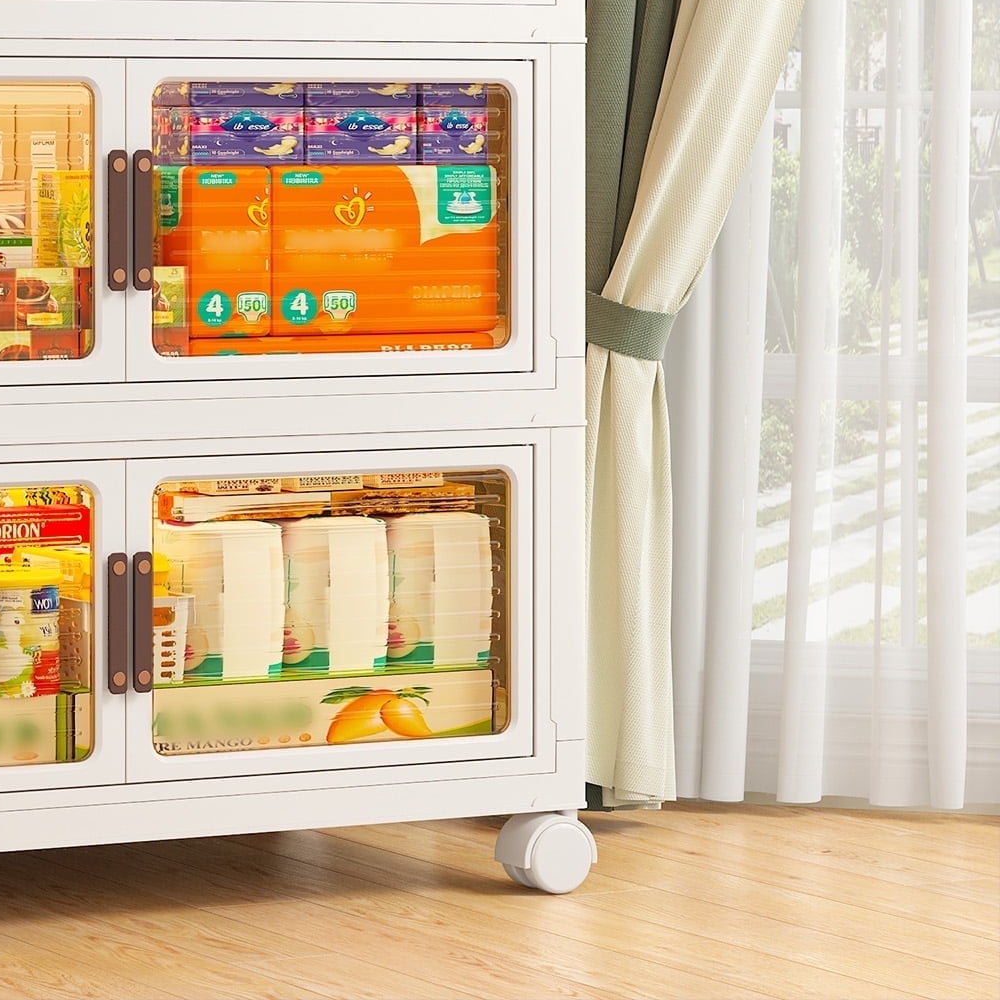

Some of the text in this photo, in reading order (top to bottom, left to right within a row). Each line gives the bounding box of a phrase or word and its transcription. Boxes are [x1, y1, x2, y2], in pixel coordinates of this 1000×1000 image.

[205, 294, 224, 317] 4
[243, 299, 261, 312] 50
[290, 292, 309, 316] 4
[330, 298, 349, 310] 50
[186, 737, 253, 750] MANGO
